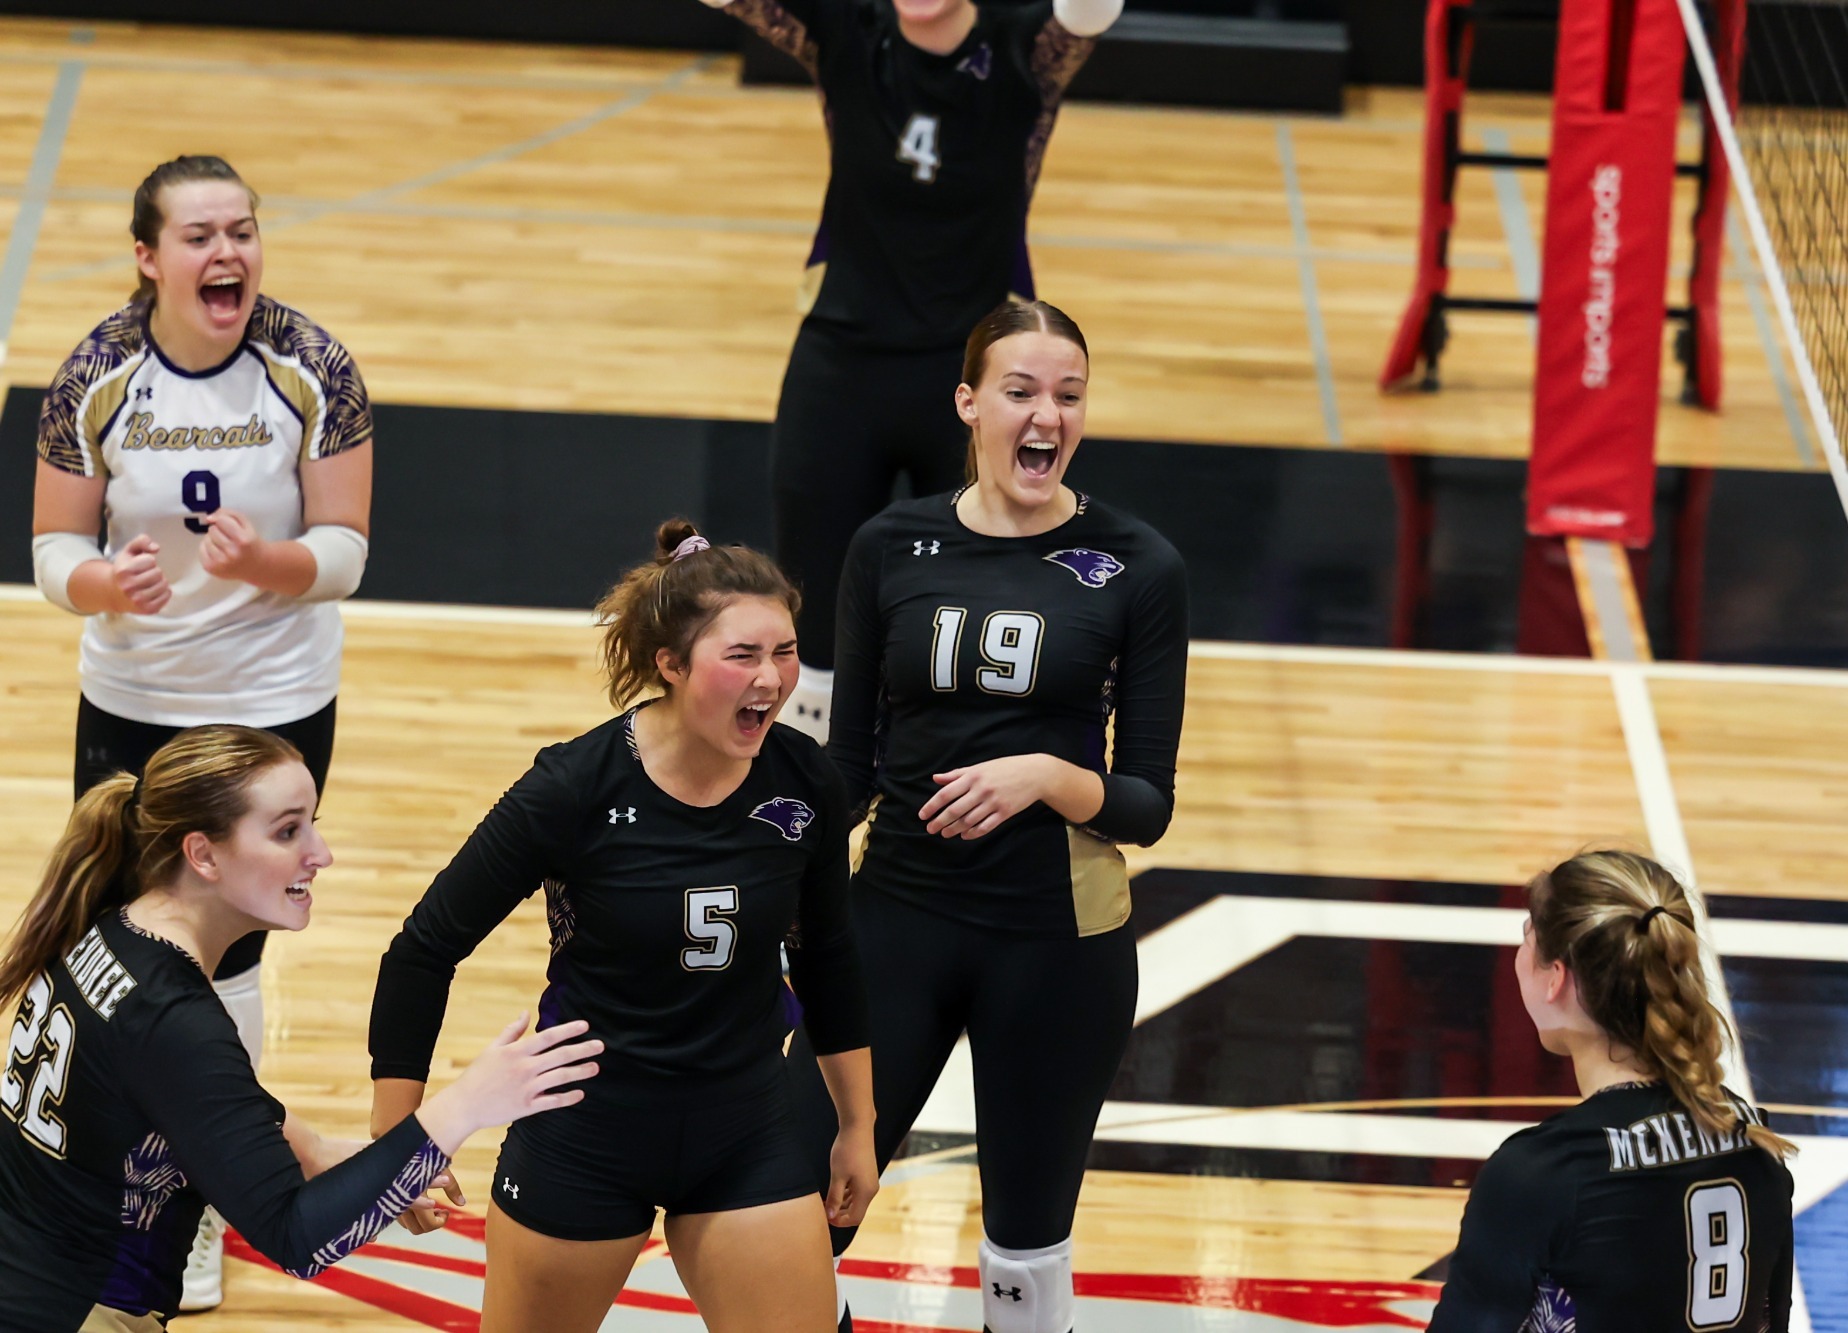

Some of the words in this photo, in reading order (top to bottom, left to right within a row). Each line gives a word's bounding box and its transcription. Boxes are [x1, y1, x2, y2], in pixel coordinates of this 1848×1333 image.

[897, 114, 941, 184] 4
[121, 411, 273, 451] Bearcats
[181, 470, 221, 534] 9
[930, 606, 1045, 697] 19
[680, 885, 739, 971] 5
[62, 924, 138, 1022] ENDREE
[0, 969, 76, 1160] 22
[1684, 1177, 1750, 1333] 8
